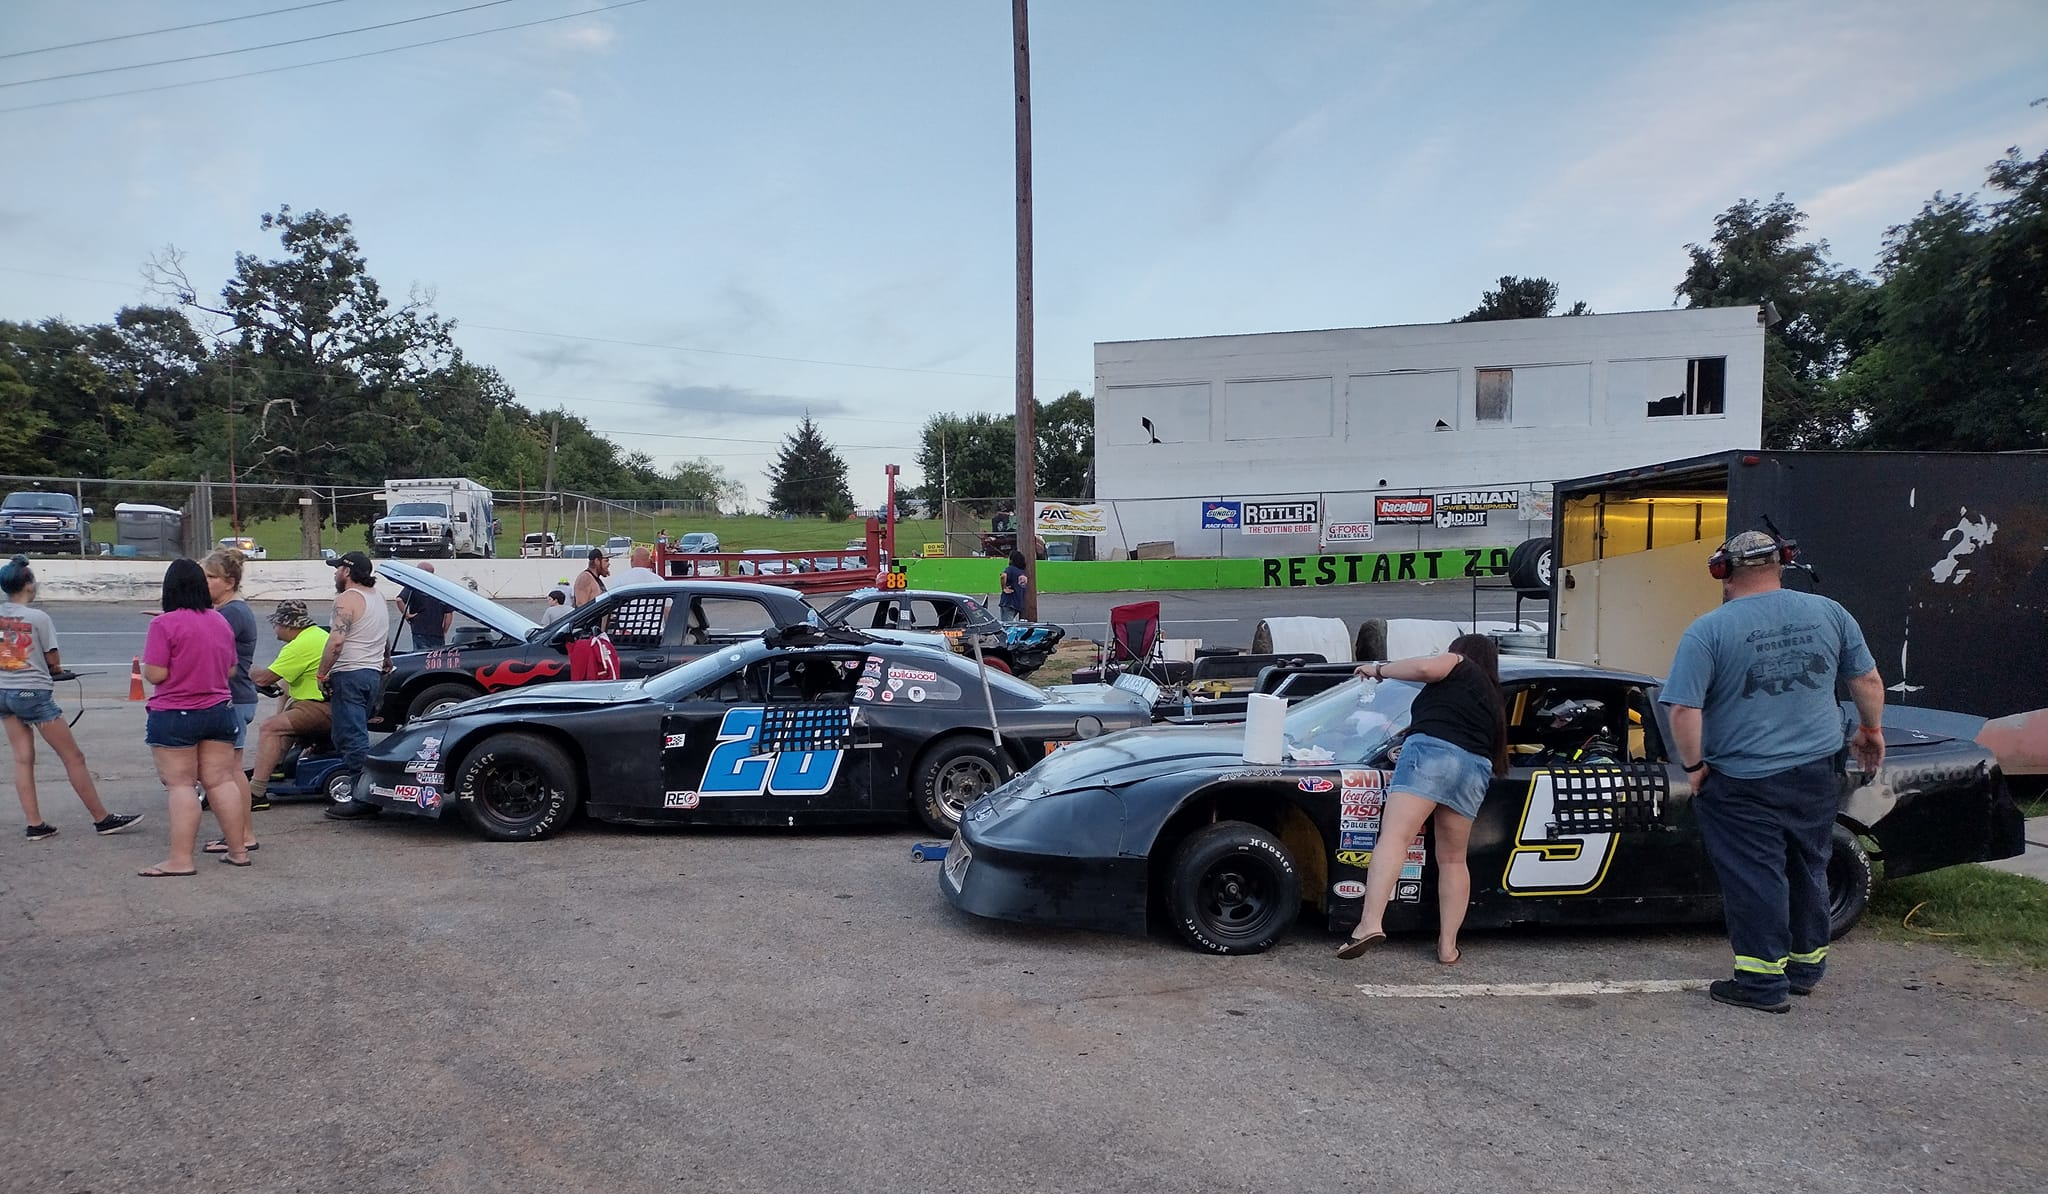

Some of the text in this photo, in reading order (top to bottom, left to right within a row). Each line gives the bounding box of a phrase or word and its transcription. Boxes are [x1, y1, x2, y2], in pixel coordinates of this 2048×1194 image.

[1437, 491, 1517, 506] FIRMAN
[1038, 509, 1074, 520] PAC
[1206, 510, 1237, 518] SUNOCO
[1246, 504, 1316, 523] ROTTLER
[1381, 501, 1428, 514] RaceQuip
[1329, 525, 1368, 533] G-FORCE
[1264, 552, 1442, 587] RESTART
[887, 573, 905, 588] 88
[1756, 635, 1813, 652] WORKWEAR
[425, 659, 442, 670] 300
[889, 671, 936, 680] wilwood
[460, 753, 495, 802] Hoosier
[1343, 771, 1379, 788] 3M
[395, 787, 418, 797] MSD
[1343, 805, 1380, 816] MSD
[1502, 770, 1627, 897] 5
[1249, 838, 1293, 873] Hoosier
[1340, 885, 1362, 893] BELL
[1185, 918, 1230, 953] Hoosier
